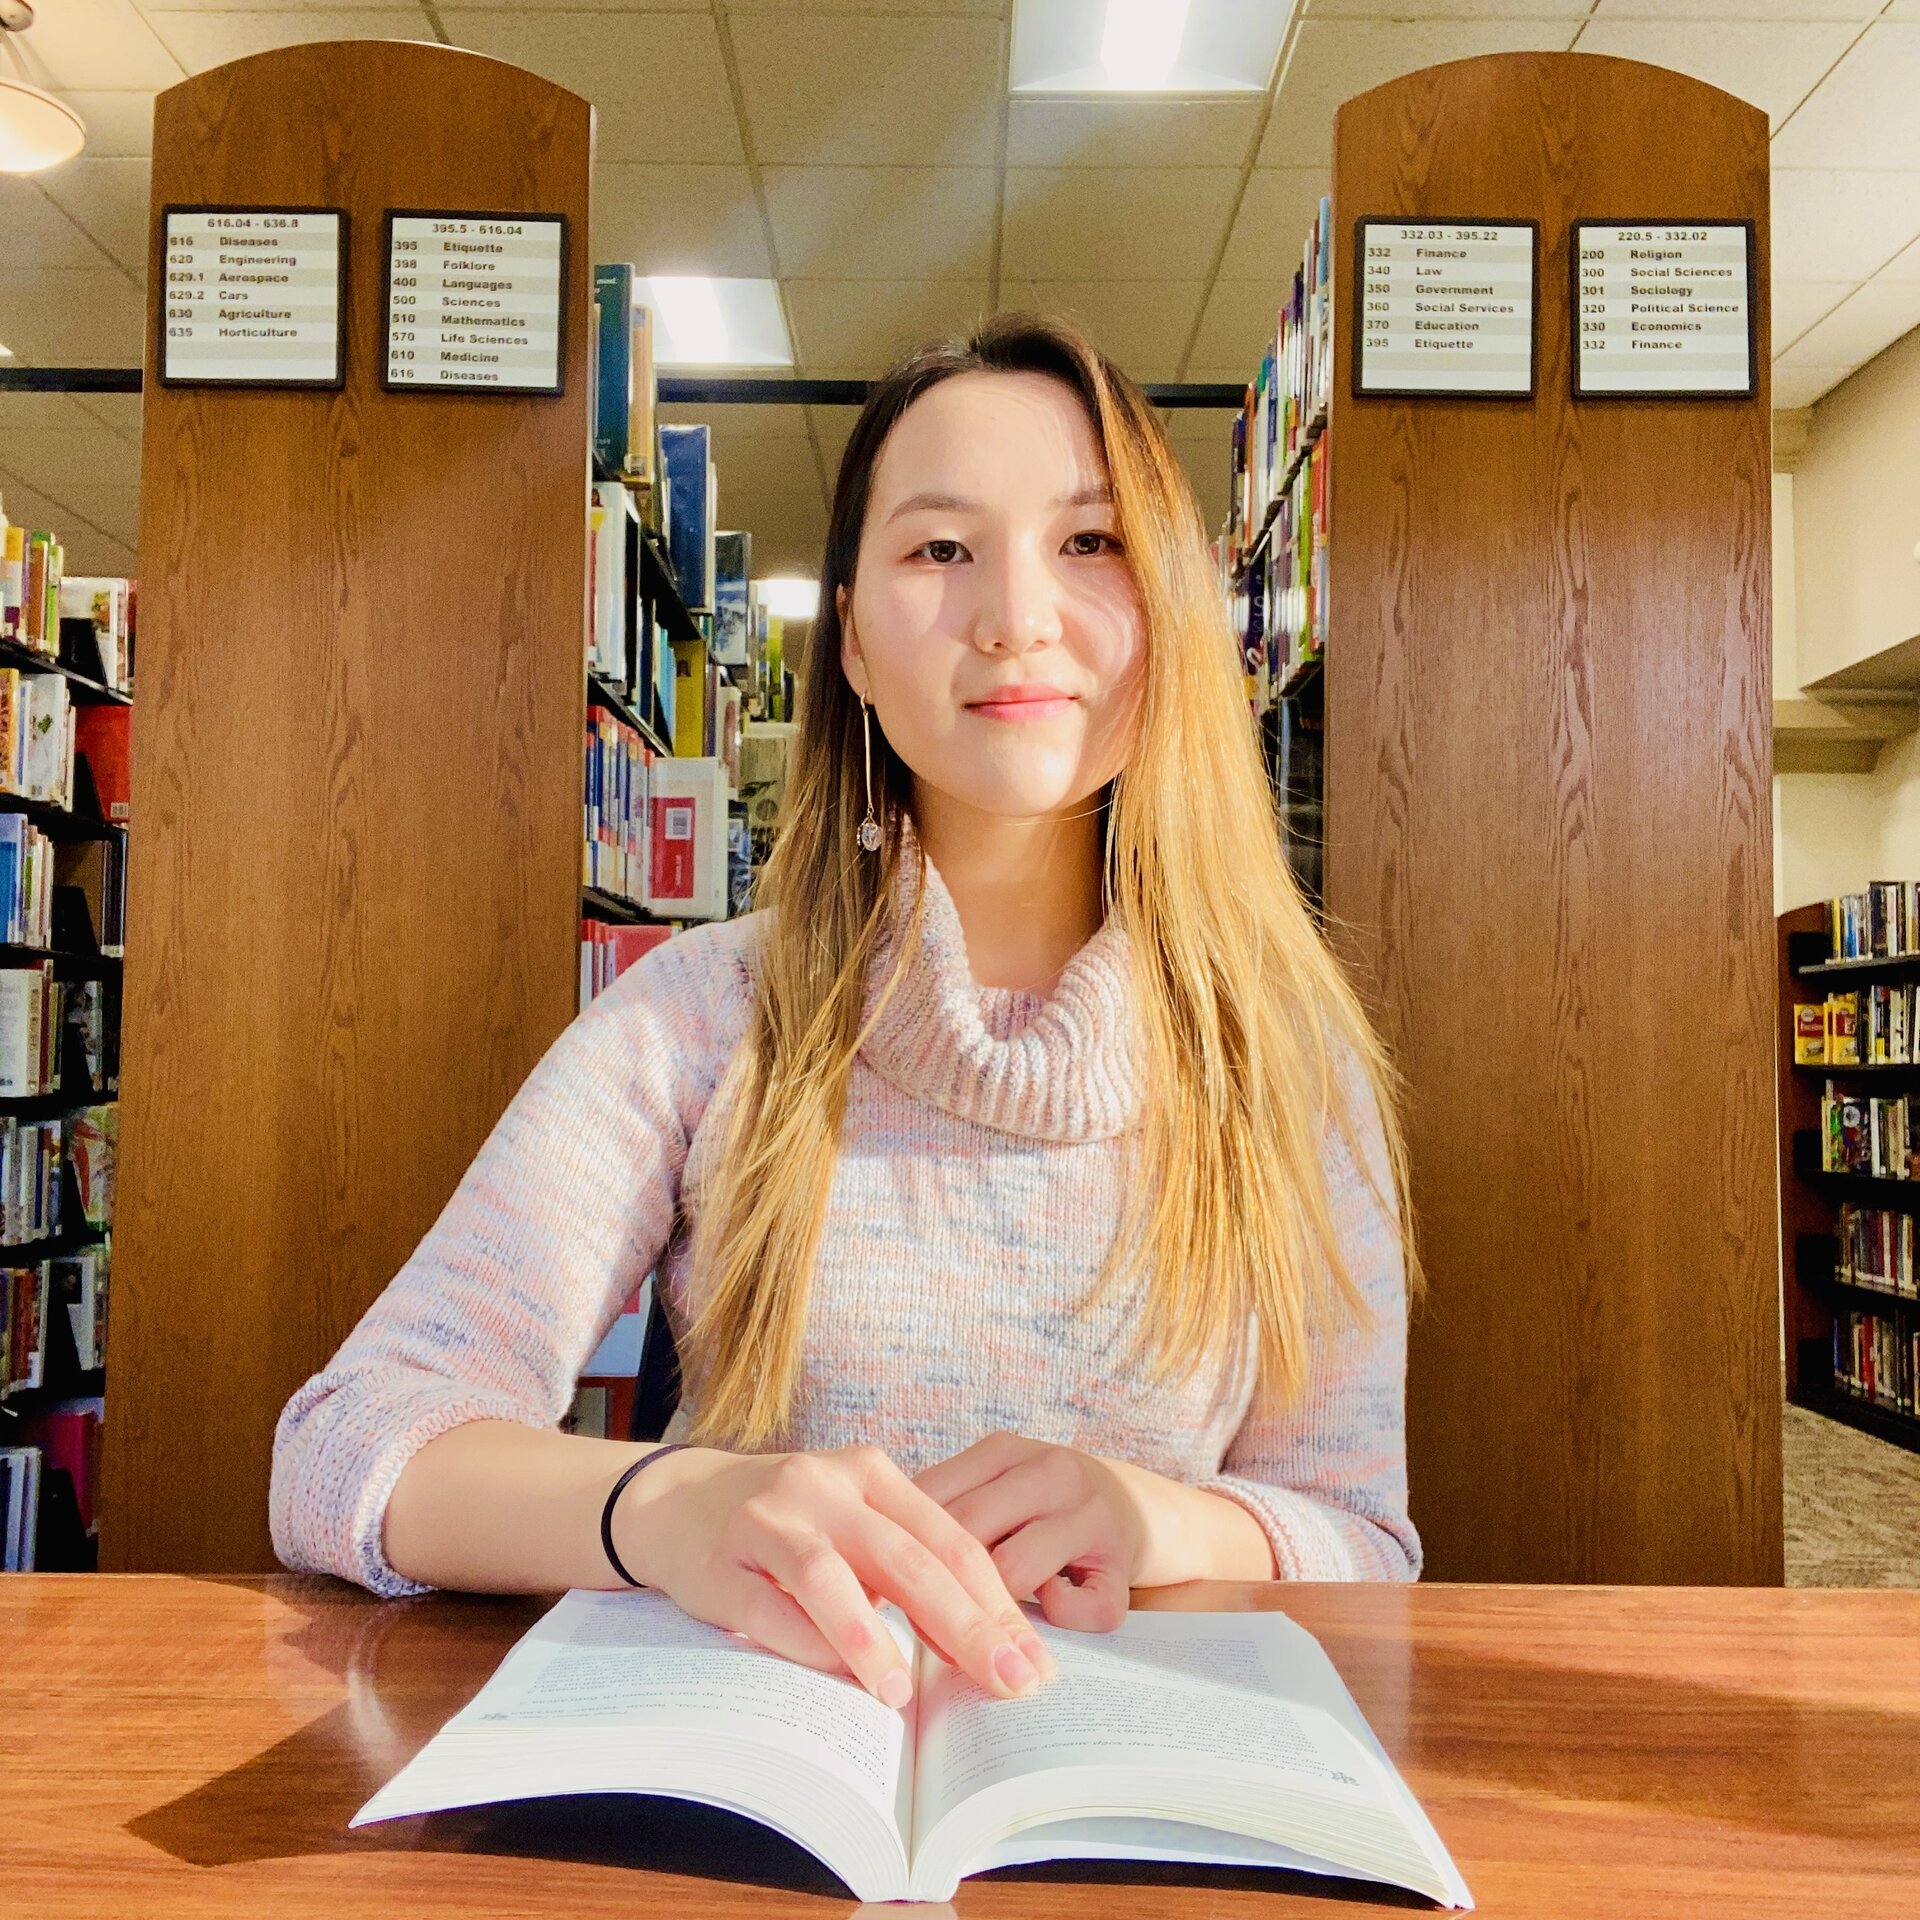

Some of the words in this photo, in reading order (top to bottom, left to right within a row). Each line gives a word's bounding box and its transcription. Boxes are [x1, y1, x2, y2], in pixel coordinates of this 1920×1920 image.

[207, 219, 251, 227] 616.04
[264, 219, 299, 228] 636.8
[432, 224, 467, 233] 395.5
[479, 226, 523, 235] 616.04
[1401, 231, 1443, 240] 332.03
[1456, 232, 1498, 240] 395.22
[1618, 232, 1652, 241] 220.5
[1665, 232, 1707, 240] 332.02
[170, 237, 194, 246] 616
[220, 237, 278, 246] Diseases
[394, 241, 418, 250] 395
[443, 242, 503, 254] Etiquette
[1368, 248, 1390, 257] 332
[1416, 249, 1467, 258] Finance
[169, 255, 193, 264] 620
[220, 255, 296, 266] Engineering
[1582, 251, 1605, 260] 200
[1630, 250, 1682, 261] Religion
[394, 260, 417, 268] 398
[443, 261, 496, 271] Folklore
[1367, 266, 1390, 275] 340
[1416, 267, 1442, 276] Law
[169, 273, 204, 282] 629.1
[219, 273, 289, 284] Aerospace
[1582, 269, 1605, 278] 300
[1631, 268, 1669, 277] Social
[1674, 268, 1732, 277] Sciences
[393, 278, 417, 287] 400
[442, 279, 512, 291] Languages
[1367, 284, 1390, 293] 350
[1416, 285, 1494, 295] Government
[169, 291, 204, 300] 629.2
[219, 291, 248, 300] Cars
[1582, 287, 1604, 295] 301
[1631, 286, 1693, 297] Sociology
[393, 296, 416, 305] 500
[442, 297, 501, 308] Sciences
[1367, 302, 1390, 311] 360
[1416, 303, 1454, 312] Social
[1459, 303, 1514, 313] Services
[1582, 305, 1605, 313] 320
[1631, 304, 1683, 313] Political
[1688, 304, 1739, 313] Science
[169, 309, 193, 318] 630
[218, 309, 291, 321] Agriculture
[392, 314, 415, 323] 510
[441, 315, 526, 327] Mathematics
[1366, 320, 1389, 329] 370
[1415, 321, 1480, 330] Education
[1583, 322, 1605, 331] 330
[1632, 322, 1702, 331] Economics
[169, 328, 193, 337] 635
[219, 328, 297, 337] Horticulture
[392, 332, 415, 341] 570
[440, 334, 465, 343] Life
[469, 334, 528, 345] Sciences
[1366, 338, 1389, 347] 395
[1414, 339, 1474, 350] Etiquette
[1583, 341, 1605, 349] 332
[1632, 340, 1682, 349] Finance
[391, 350, 415, 360] 610
[440, 352, 499, 363] Medicine
[391, 369, 414, 378] 616
[440, 370, 498, 381] Diseases
